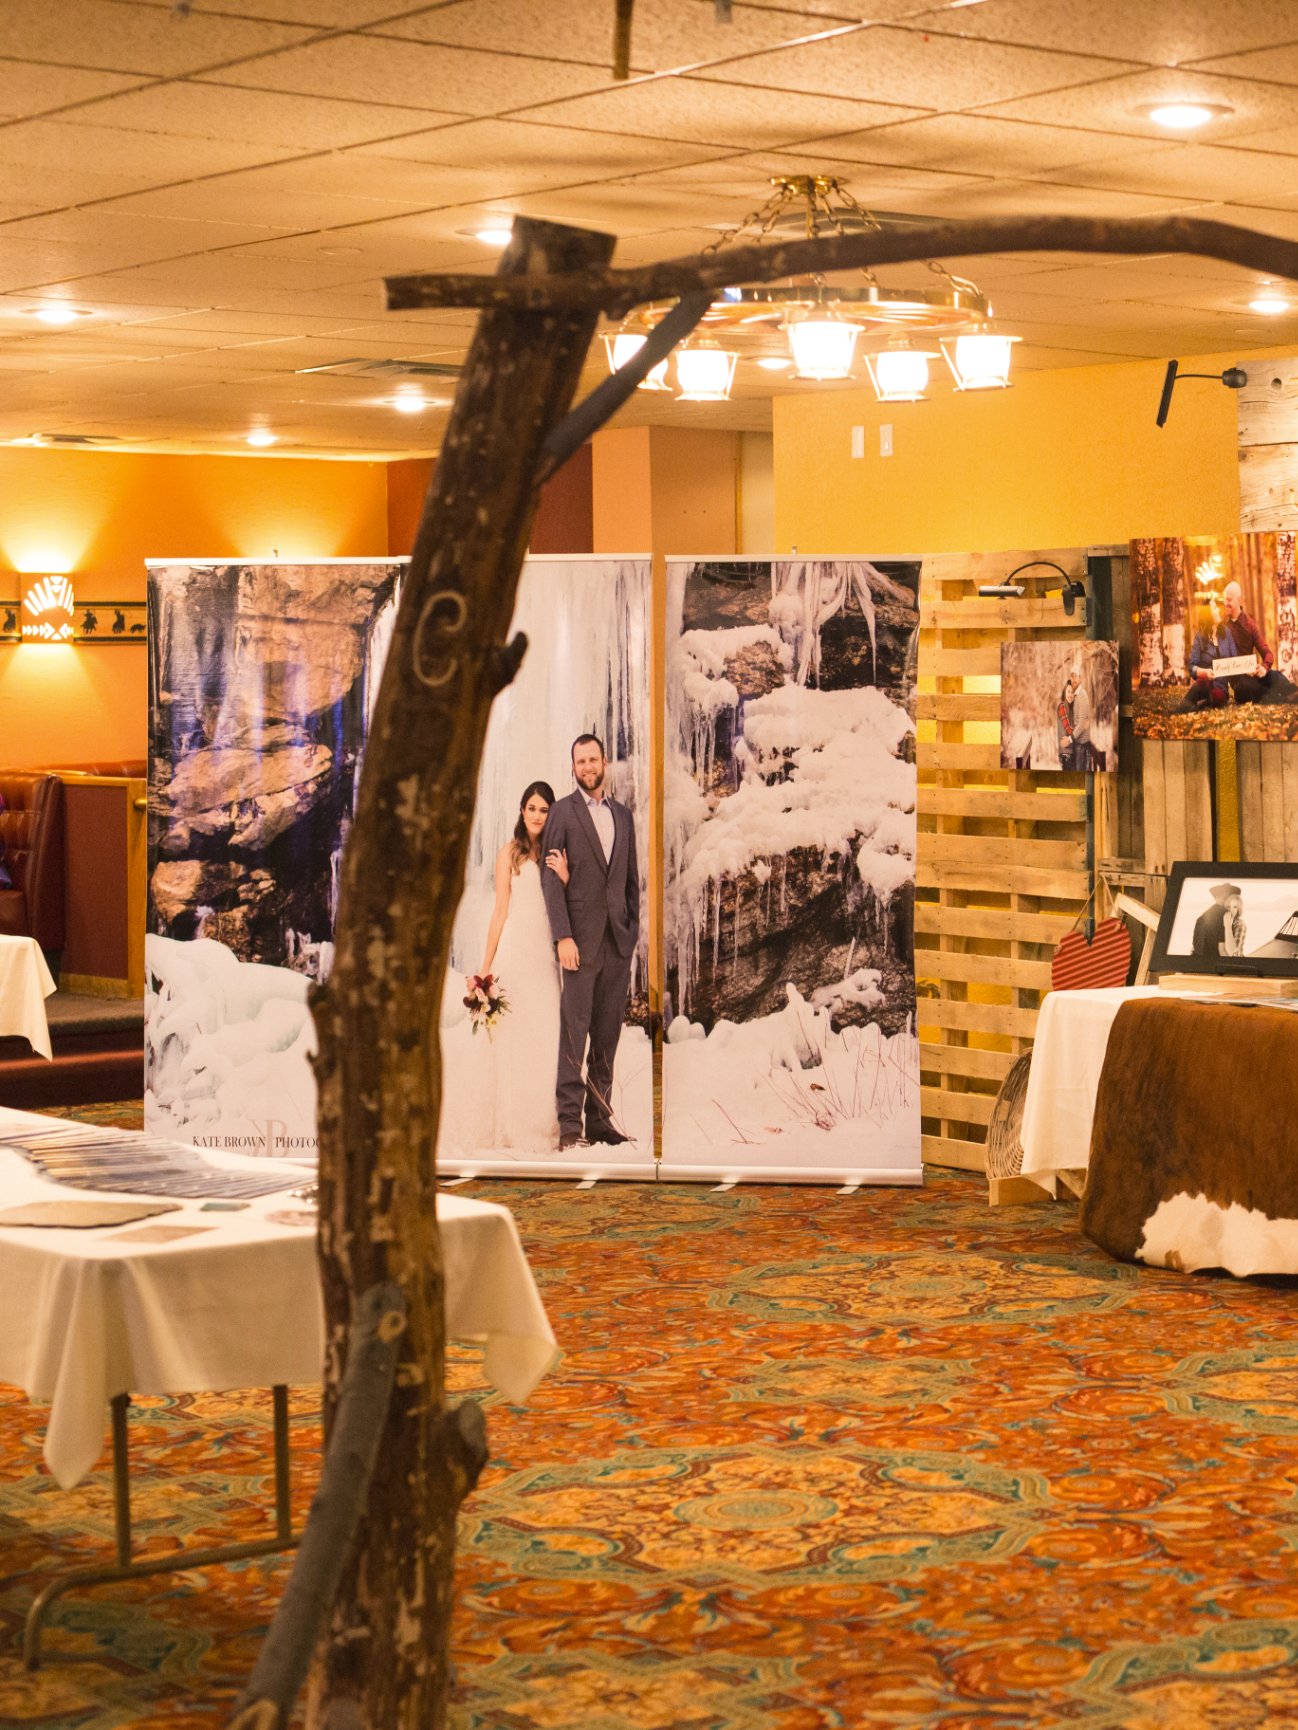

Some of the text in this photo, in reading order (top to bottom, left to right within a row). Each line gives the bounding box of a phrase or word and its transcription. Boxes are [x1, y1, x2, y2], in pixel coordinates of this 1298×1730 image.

[192, 1136, 319, 1149] KATE BROWN PHOTO
